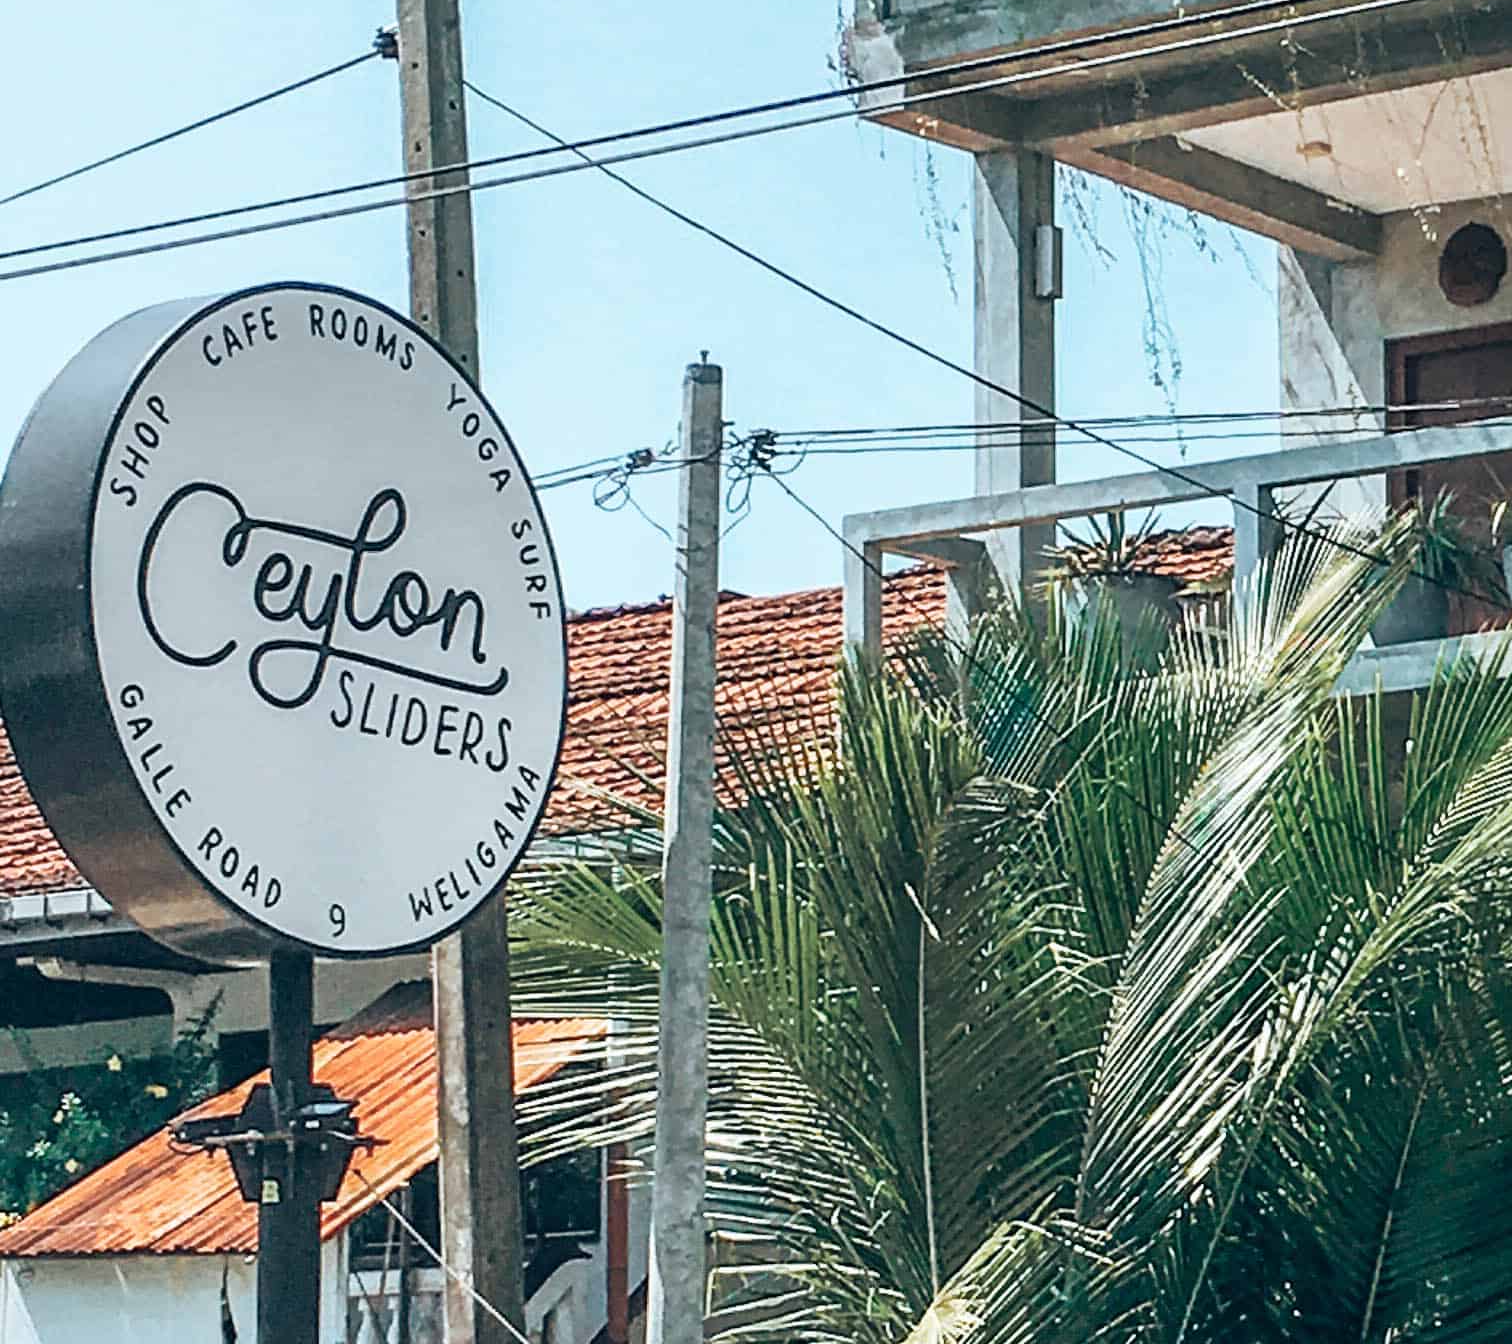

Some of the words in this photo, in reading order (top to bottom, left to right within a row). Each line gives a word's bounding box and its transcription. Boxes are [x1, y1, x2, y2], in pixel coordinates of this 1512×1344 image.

[110, 396, 170, 507] SHOP
[203, 306, 278, 366] CAFE
[309, 304, 415, 370] ROOMS
[447, 383, 511, 493] YOGA
[511, 519, 551, 619] SURF
[137, 482, 509, 709] Ceylon
[120, 684, 191, 818] GALLE
[197, 827, 281, 908] ROAD
[408, 766, 540, 922] WELIGAMA
[330, 670, 512, 772] SLIDERS
